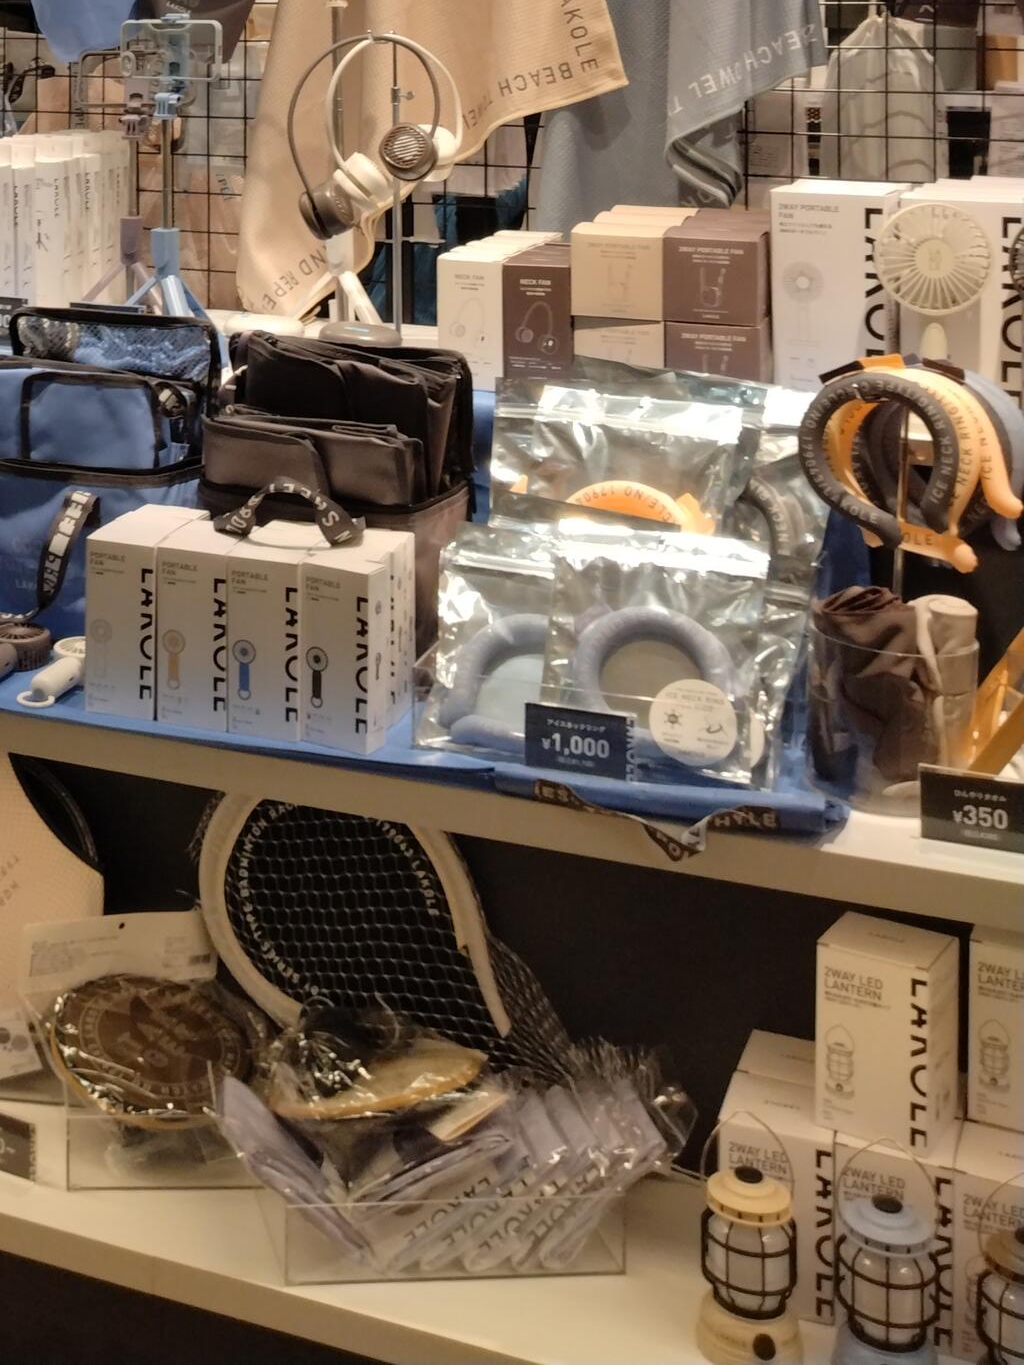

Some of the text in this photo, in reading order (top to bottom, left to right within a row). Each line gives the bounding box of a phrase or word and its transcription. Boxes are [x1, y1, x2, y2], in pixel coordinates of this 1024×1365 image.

[497, 62, 573, 97] BEACH
[930, 486, 947, 504] ICE
[941, 435, 953, 473] NECK
[956, 447, 973, 487] NECK
[90, 551, 125, 563] PORTABLE
[90, 558, 104, 566] FAN
[162, 561, 198, 572] PORTABLE
[162, 568, 175, 576] FAN
[232, 570, 268, 581] PORTABLE
[232, 577, 246, 585] FAN
[541, 733, 610, 759] ¥1,000
[952, 804, 1008, 829] ¥350
[238, 819, 269, 899] BADMINTON
[412, 861, 441, 917] LAKOLE
[824, 966, 884, 990] 2WAY LED
[978, 962, 1010, 976] 2WAY
[824, 980, 882, 1001] LANTERN
[729, 1141, 788, 1165] 2WAY LED
[729, 1155, 787, 1175] LANTERN
[842, 1166, 906, 1189] 2WAY LED
[963, 1193, 997, 1211] 2WAY
